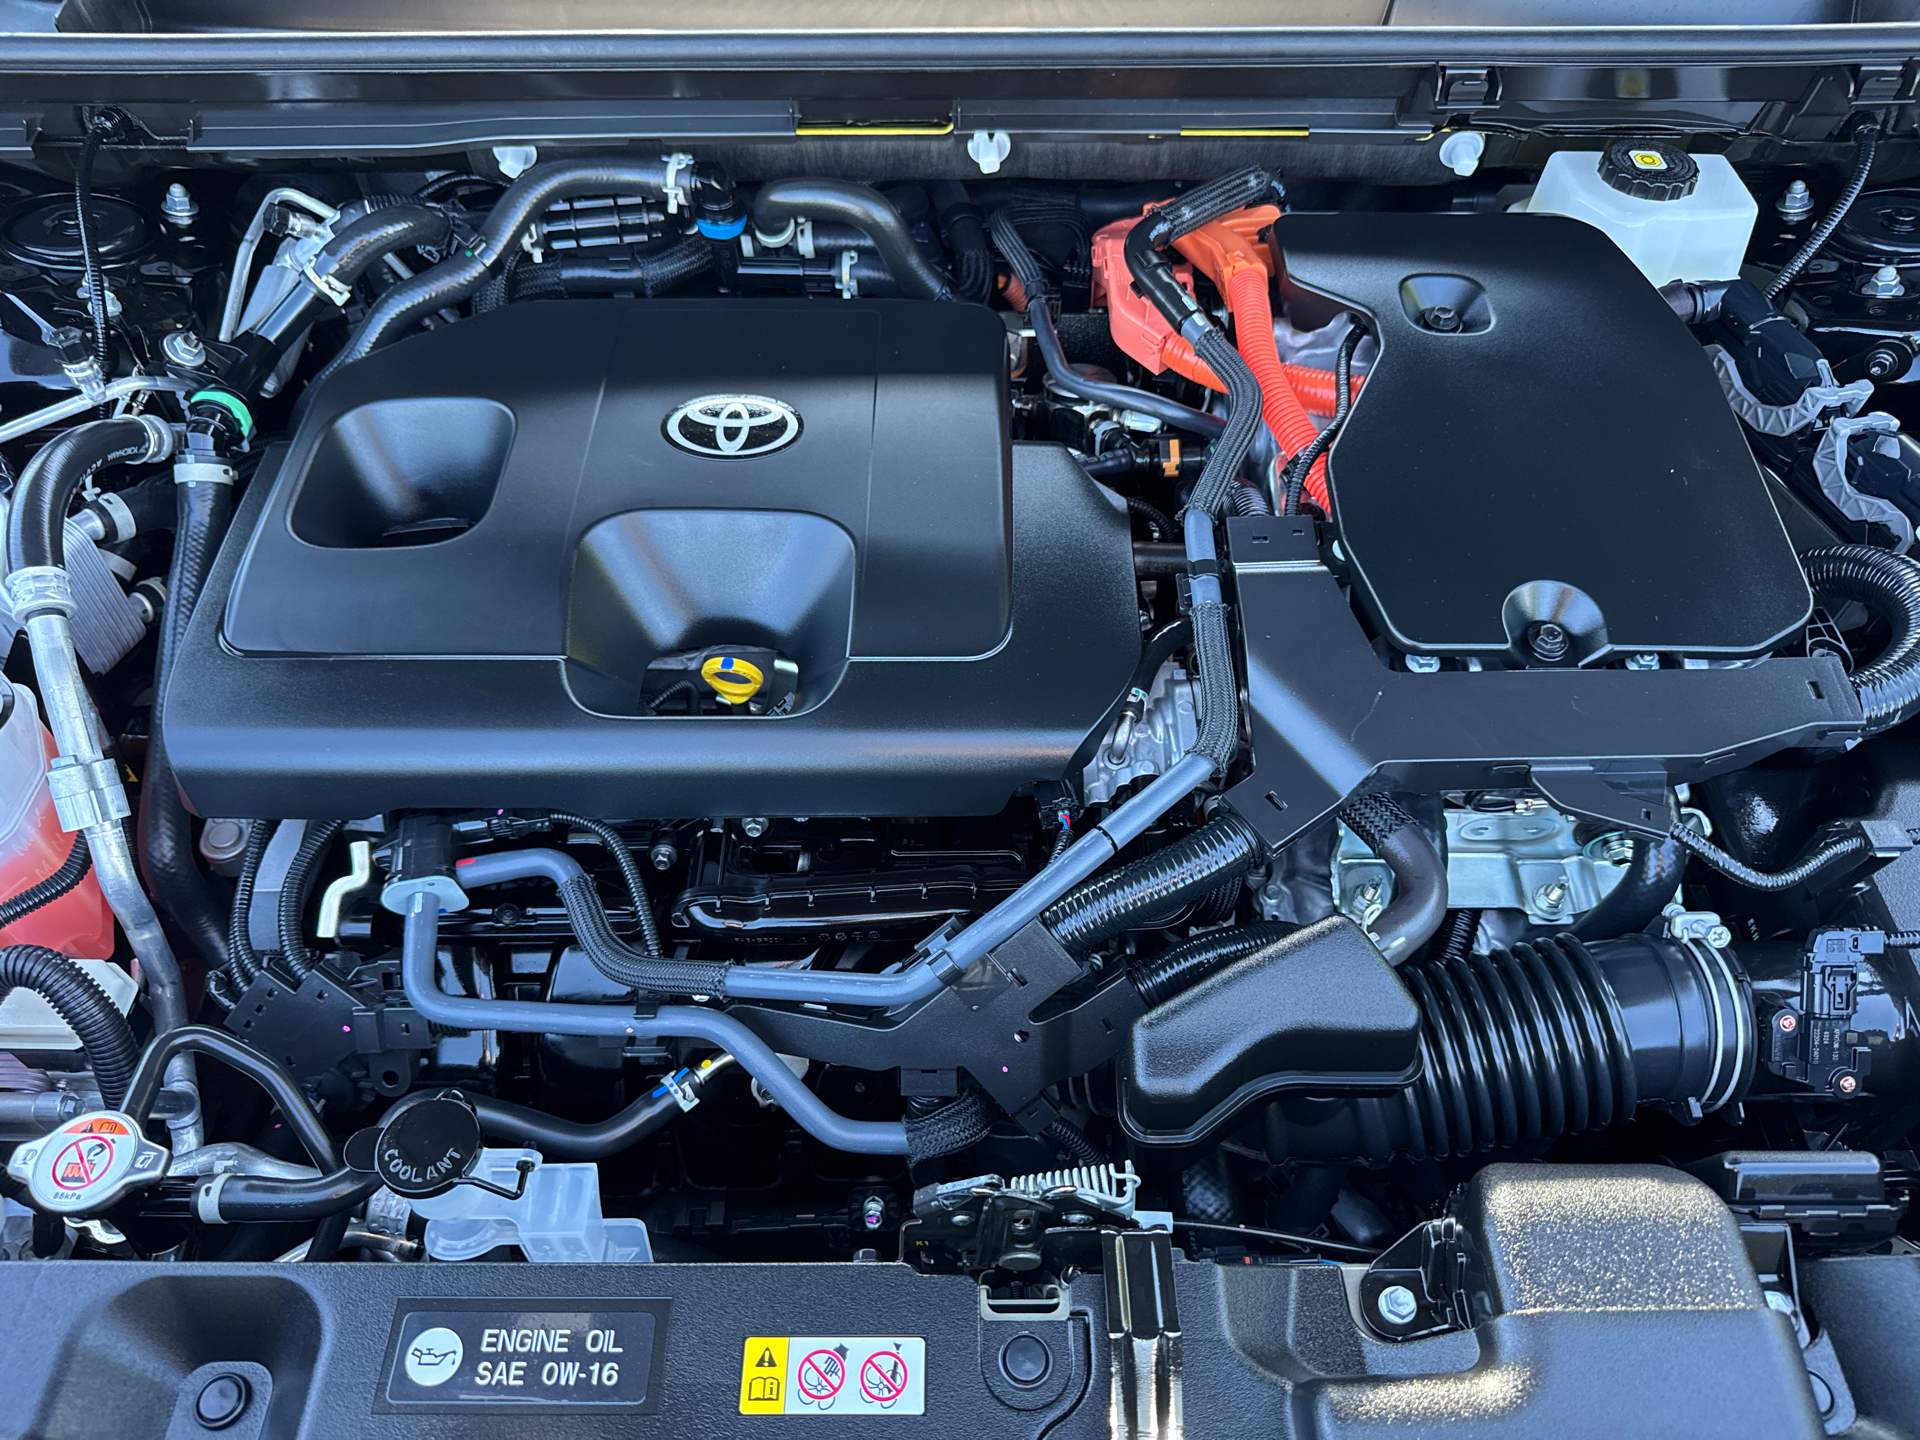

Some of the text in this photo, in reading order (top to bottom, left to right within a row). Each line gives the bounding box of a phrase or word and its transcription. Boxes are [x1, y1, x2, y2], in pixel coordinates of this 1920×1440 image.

[384, 1147, 461, 1183] COOLANT
[53, 1191, 82, 1200] 88kPa
[480, 1328, 624, 1353] ENGINE OIL
[474, 1361, 619, 1386] SAE 0W-16
